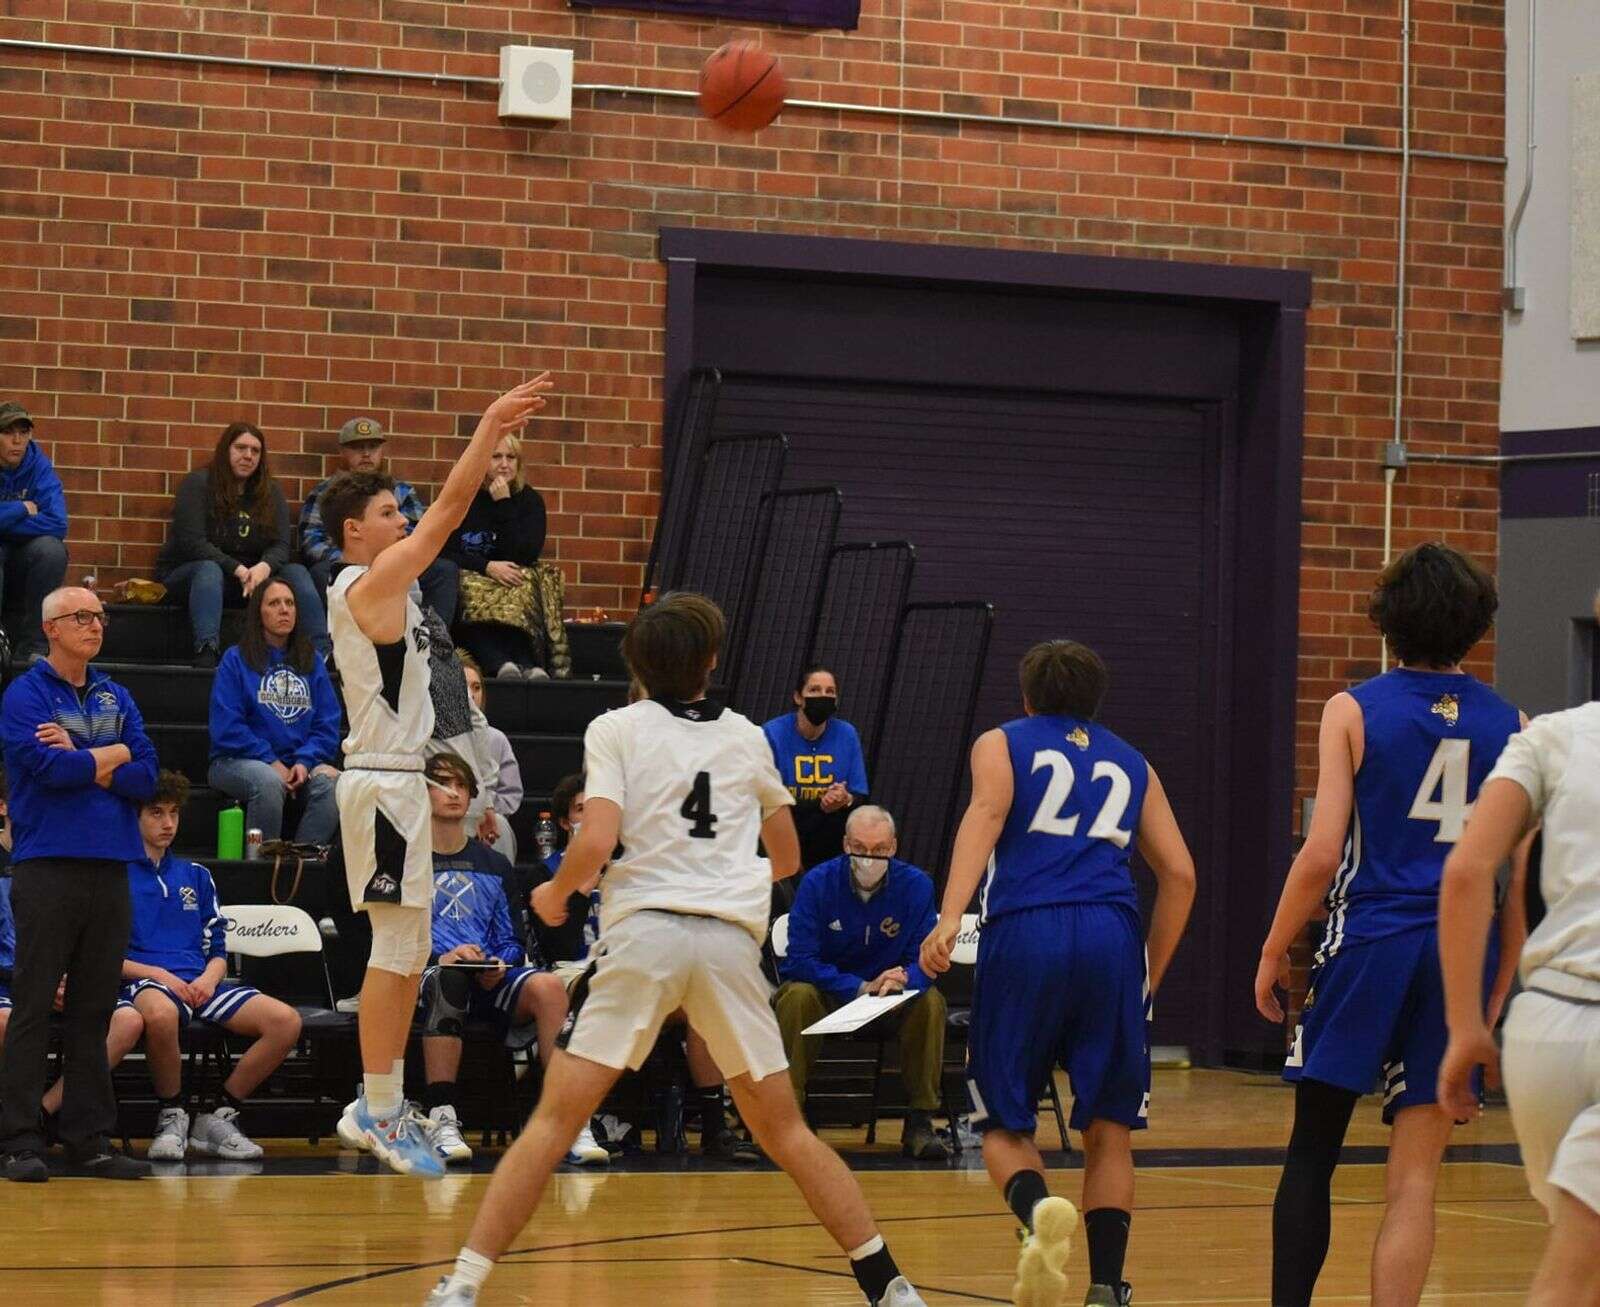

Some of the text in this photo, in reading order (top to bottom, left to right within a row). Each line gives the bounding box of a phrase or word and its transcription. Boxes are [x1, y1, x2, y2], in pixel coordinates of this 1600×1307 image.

[795, 755, 833, 784] CC
[1407, 738, 1475, 843] 4
[680, 771, 718, 839] 4
[1027, 748, 1132, 850] 22
[223, 918, 299, 937] Panthers
[880, 917, 900, 937] CC
